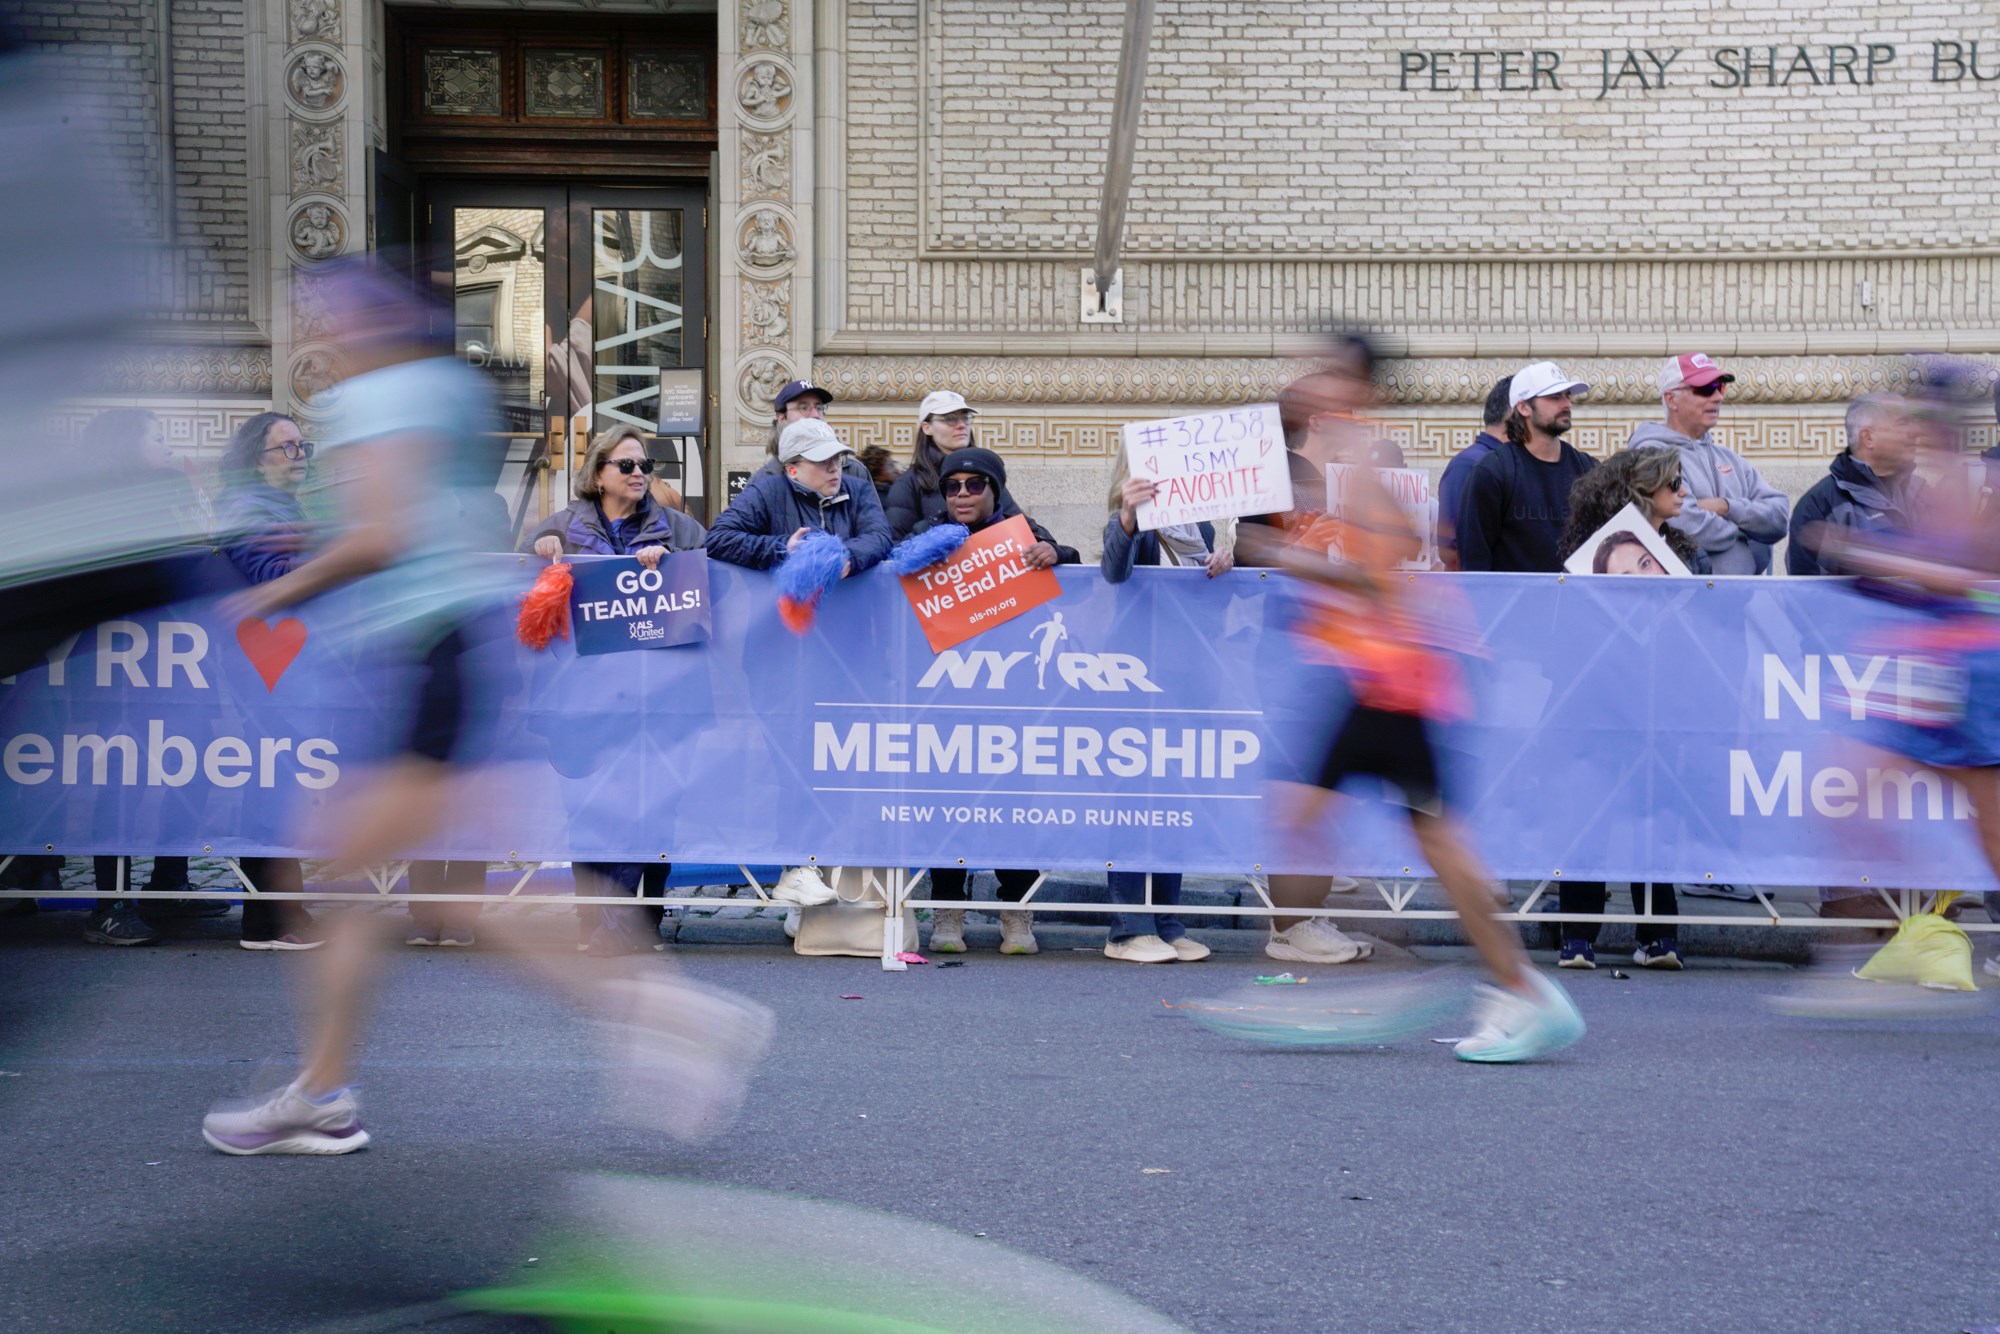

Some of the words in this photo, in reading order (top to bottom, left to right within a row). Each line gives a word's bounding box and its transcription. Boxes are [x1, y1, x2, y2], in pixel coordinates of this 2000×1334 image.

[1399, 50, 1562, 91] PETER
[1597, 48, 1683, 99] JAY
[1710, 42, 1896, 88] SHARP
[1391, 471, 1428, 504] DOING
[1504, 504, 1569, 521] ULULE
[918, 538, 1023, 591] Together,
[616, 569, 663, 594] GO
[917, 593, 954, 618] We
[954, 571, 996, 603] End
[579, 597, 647, 621] TEAM
[654, 589, 701, 613] ALS!
[969, 597, 1017, 624] als-ny.org
[637, 620, 653, 630] ALS
[637, 627, 664, 638] United
[0, 620, 209, 689] YRR
[3, 719, 340, 790] embers
[813, 721, 1260, 779] MEMBERSHIP
[881, 806, 935, 822] NEW
[941, 807, 1003, 824] YORK
[1012, 808, 1077, 825] ROAD
[1085, 810, 1194, 828] RUNNERS
[1272, 936, 1290, 946] HOKA
